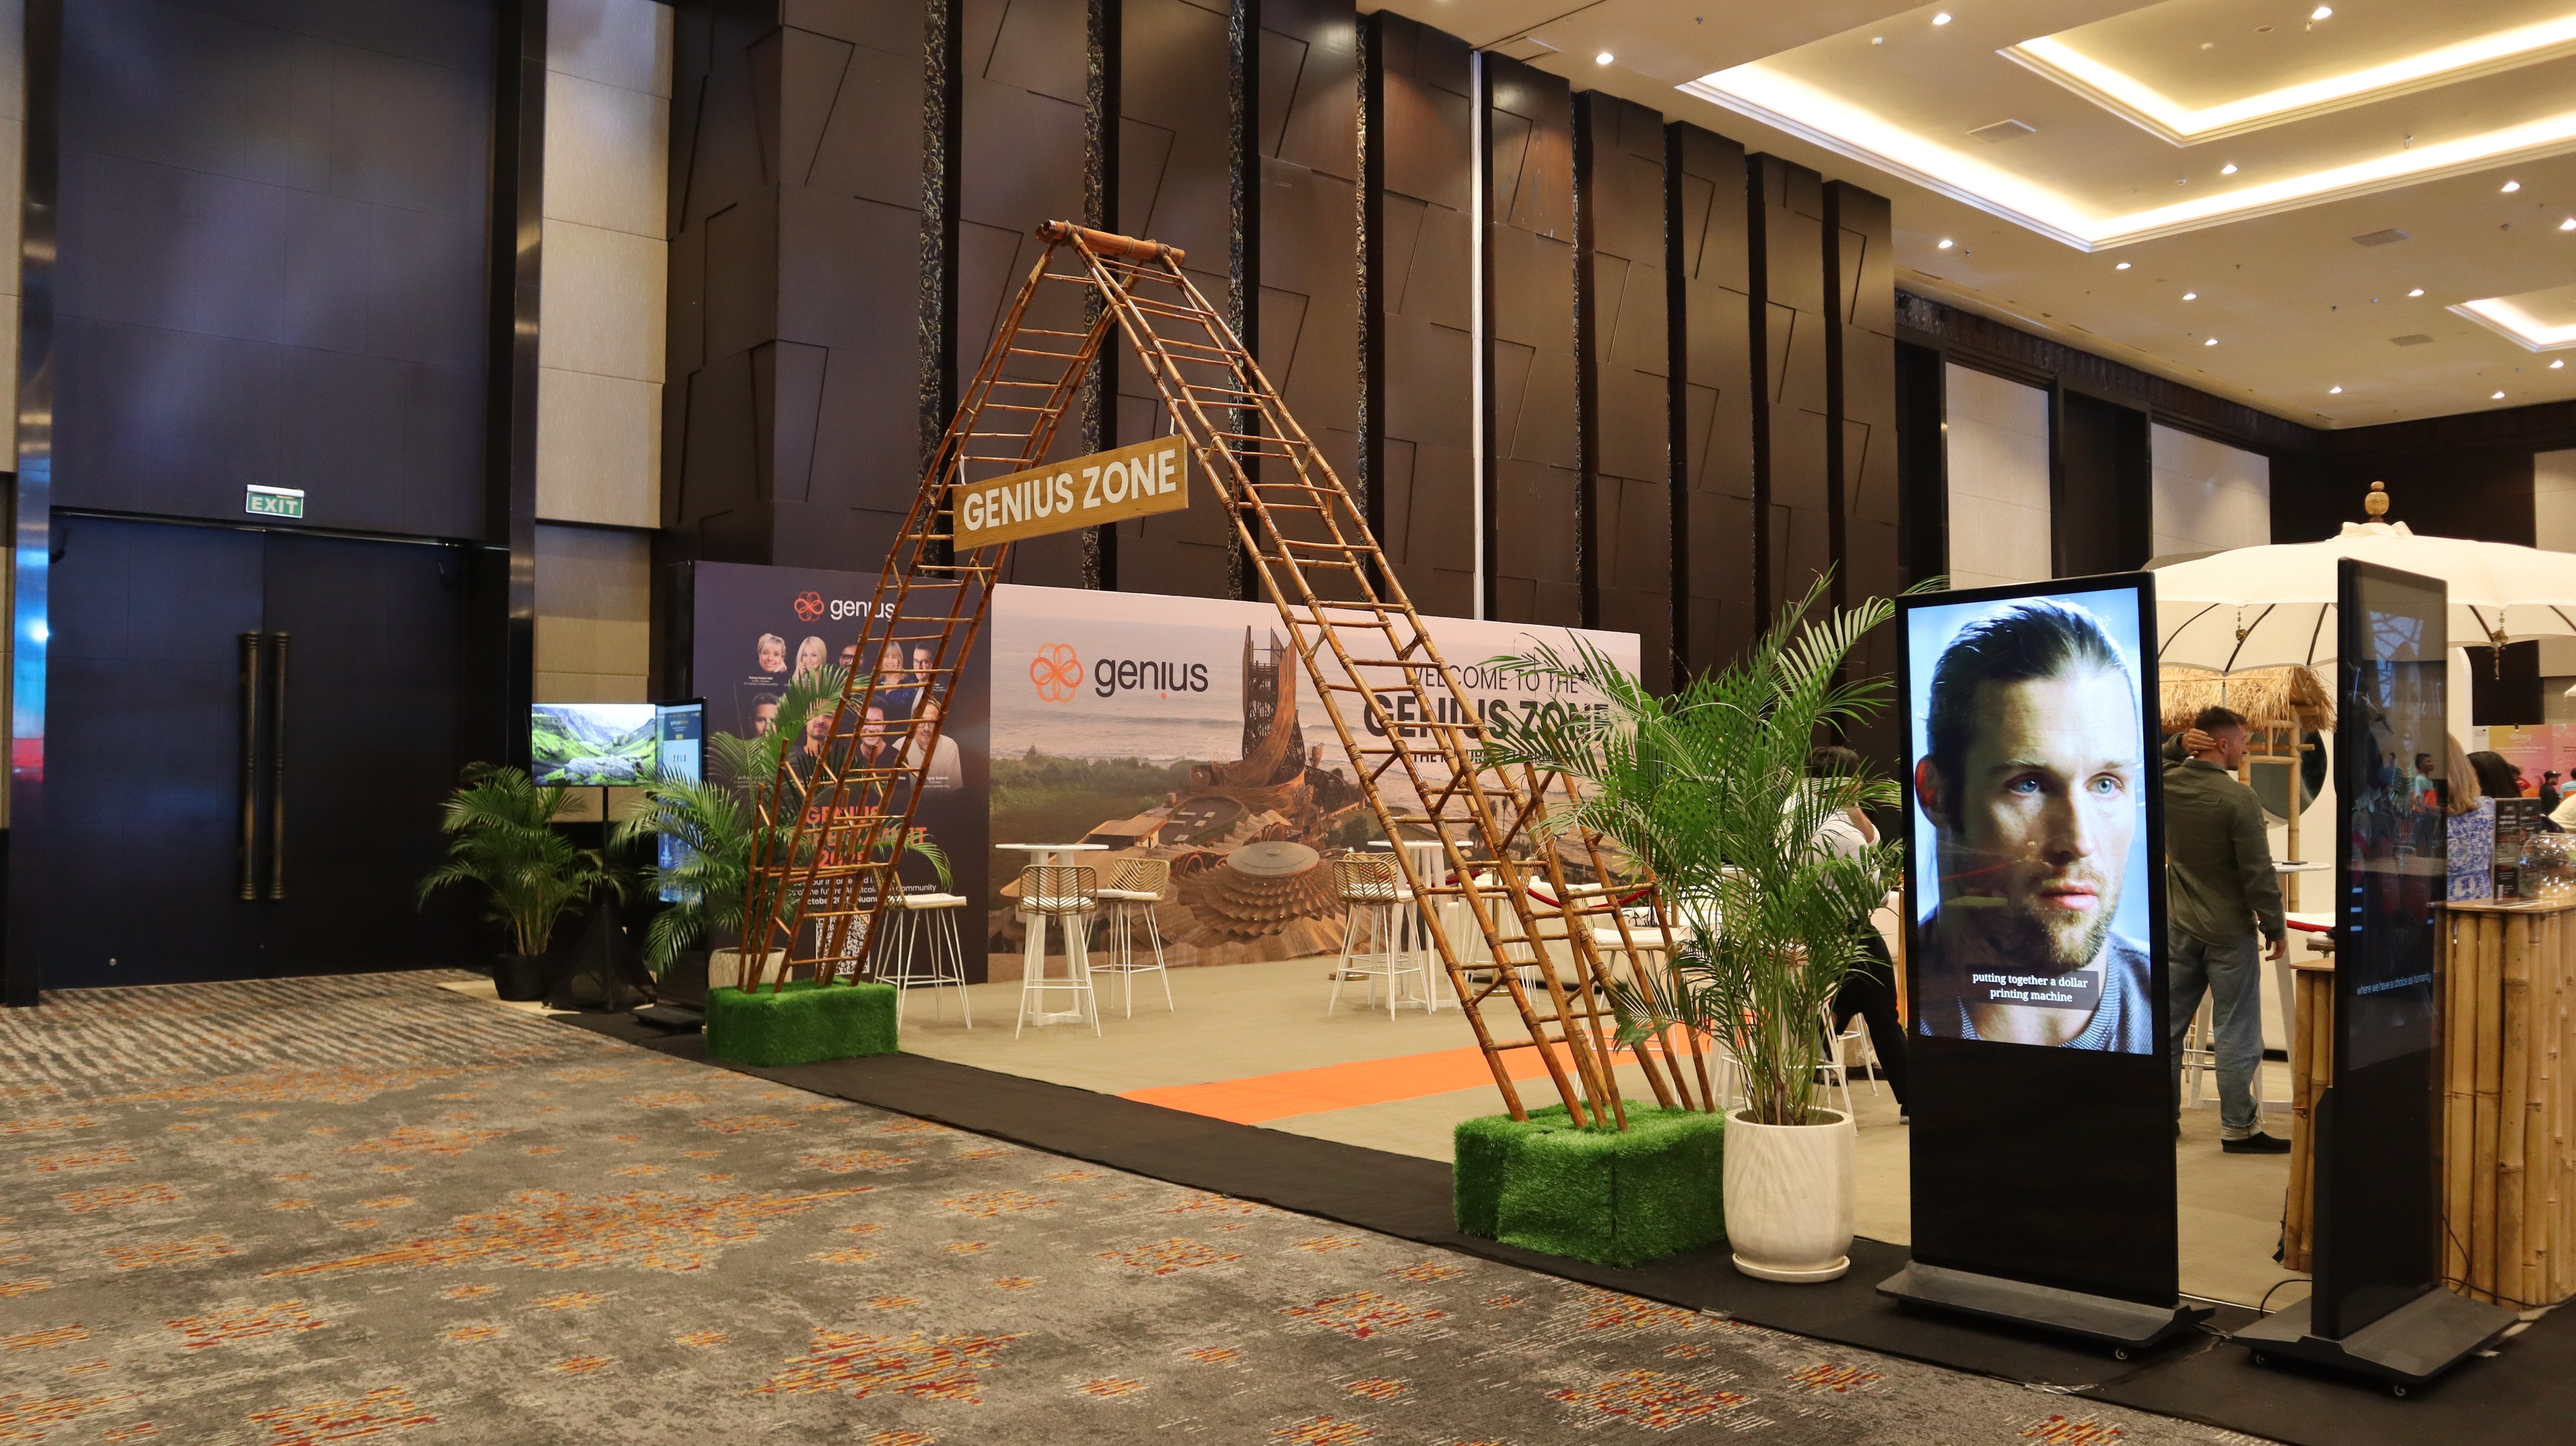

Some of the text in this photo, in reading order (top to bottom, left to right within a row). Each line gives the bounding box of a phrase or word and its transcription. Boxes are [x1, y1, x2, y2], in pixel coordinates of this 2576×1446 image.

[963, 449, 1176, 531] GENIUS ZONE
[251, 497, 298, 514] EXIT
[830, 599, 896, 620] genius
[1095, 659, 1209, 700] genius
[1515, 669, 1540, 692] TO
[1546, 671, 1578, 694] THE
[1413, 750, 1437, 762] HE
[807, 896, 827, 905] ctobe
[1972, 973, 2006, 986] putting
[2008, 974, 2048, 987] together
[2058, 977, 2088, 988] dollar
[2357, 984, 2371, 995] where
[2372, 984, 2379, 992] we
[2379, 981, 2390, 990] have
[1990, 988, 2073, 1002] printing machine
